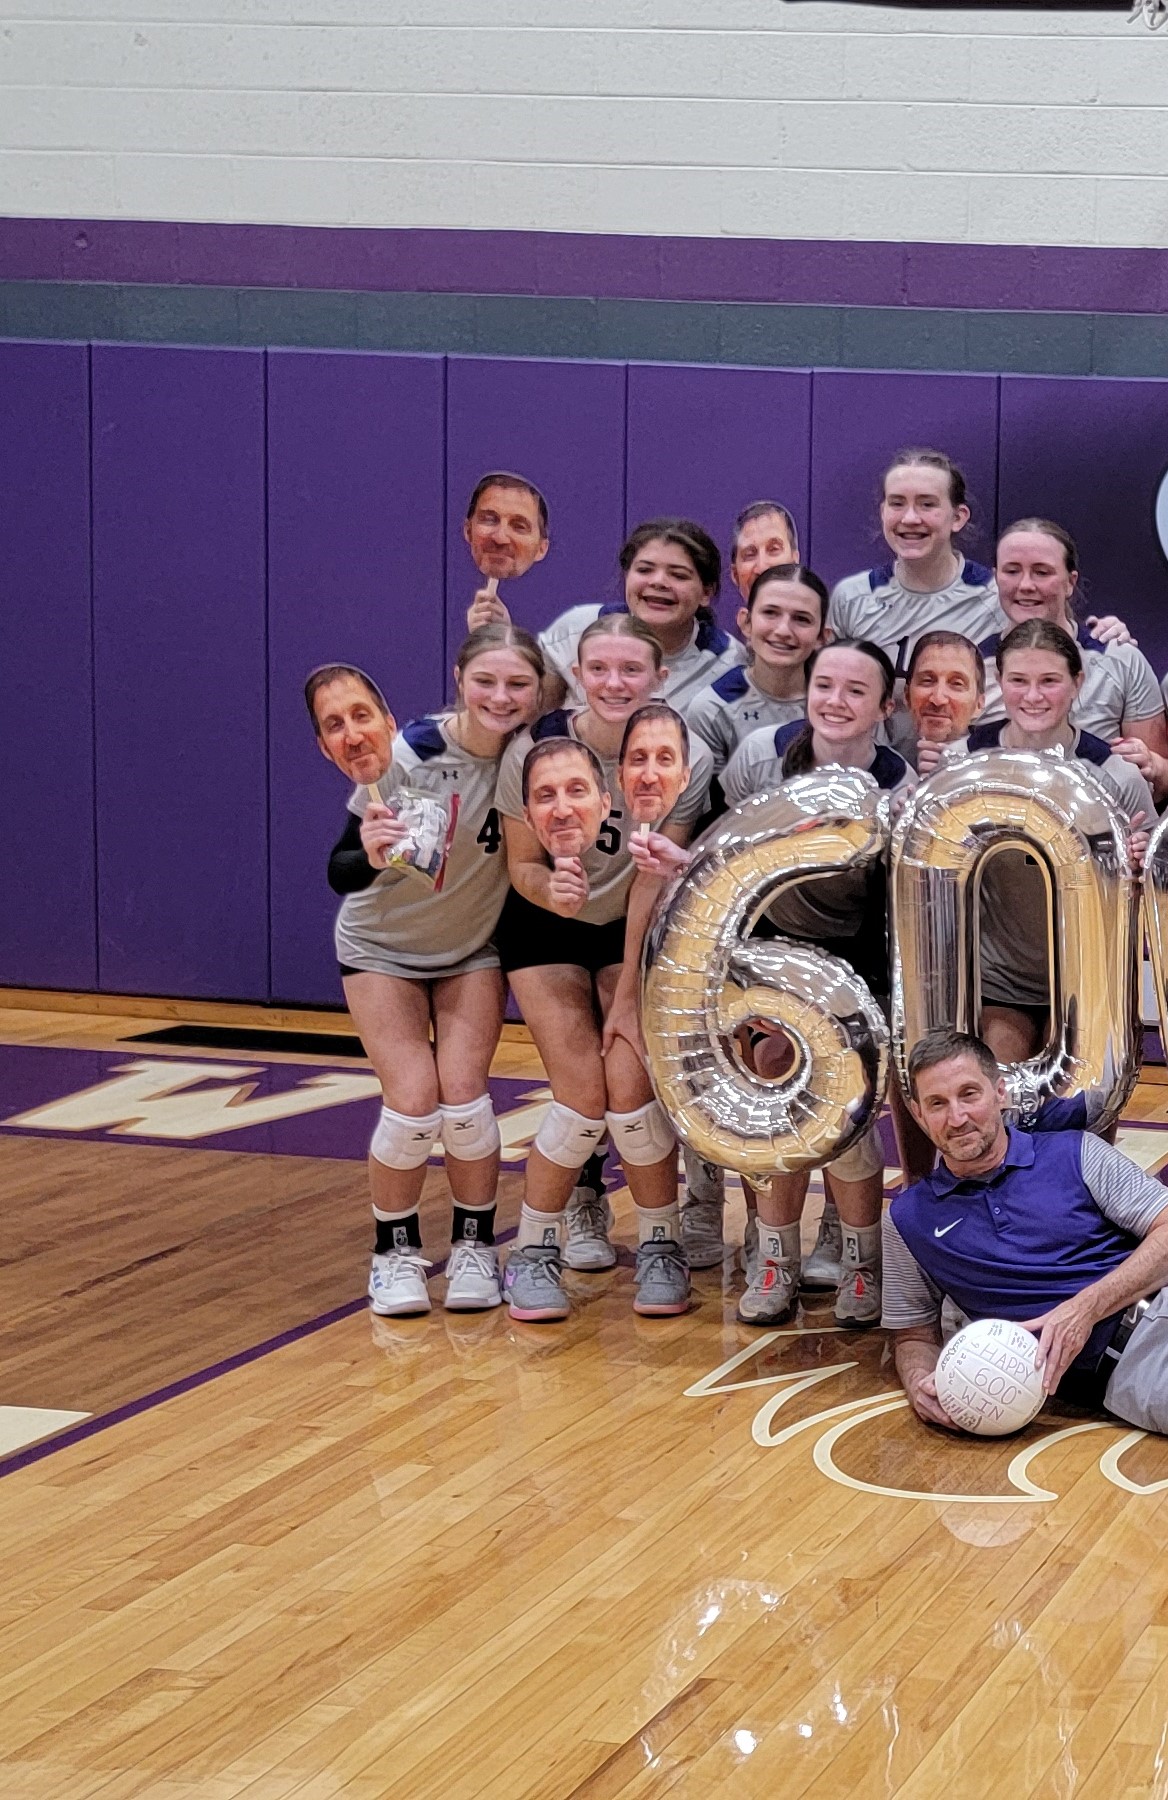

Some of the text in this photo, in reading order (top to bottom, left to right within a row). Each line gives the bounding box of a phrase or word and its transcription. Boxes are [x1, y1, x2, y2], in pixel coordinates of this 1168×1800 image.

[476, 807, 502, 854] 4
[595, 809, 623, 856] 5
[979, 1342, 1034, 1384] HAPPY
[961, 1385, 1005, 1421] WIN
